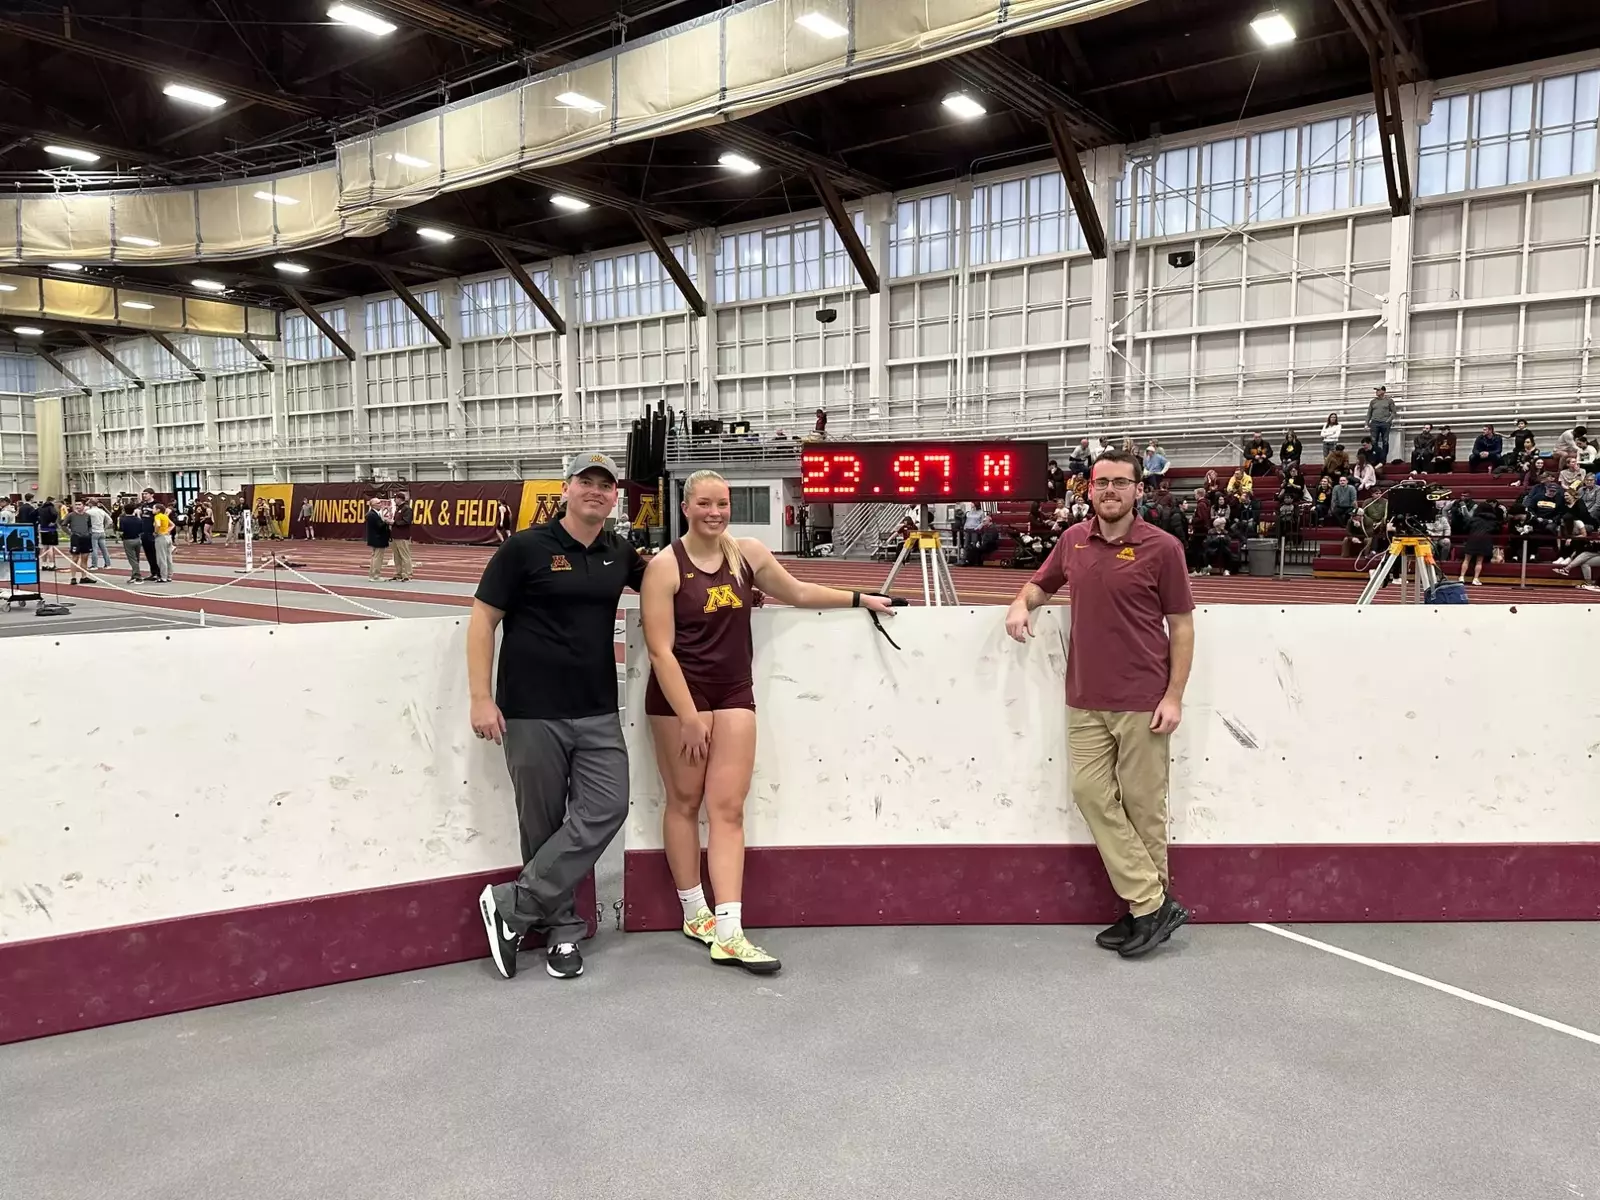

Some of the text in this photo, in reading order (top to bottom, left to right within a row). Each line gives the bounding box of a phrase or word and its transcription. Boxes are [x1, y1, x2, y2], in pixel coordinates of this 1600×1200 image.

[803, 454, 1010, 493] 23.97 M
[309, 499, 370, 523] MINNESO
[438, 500, 450, 526] &
[455, 499, 498, 527] FIELD
[703, 584, 743, 613] M
[703, 918, 716, 932] NIK
